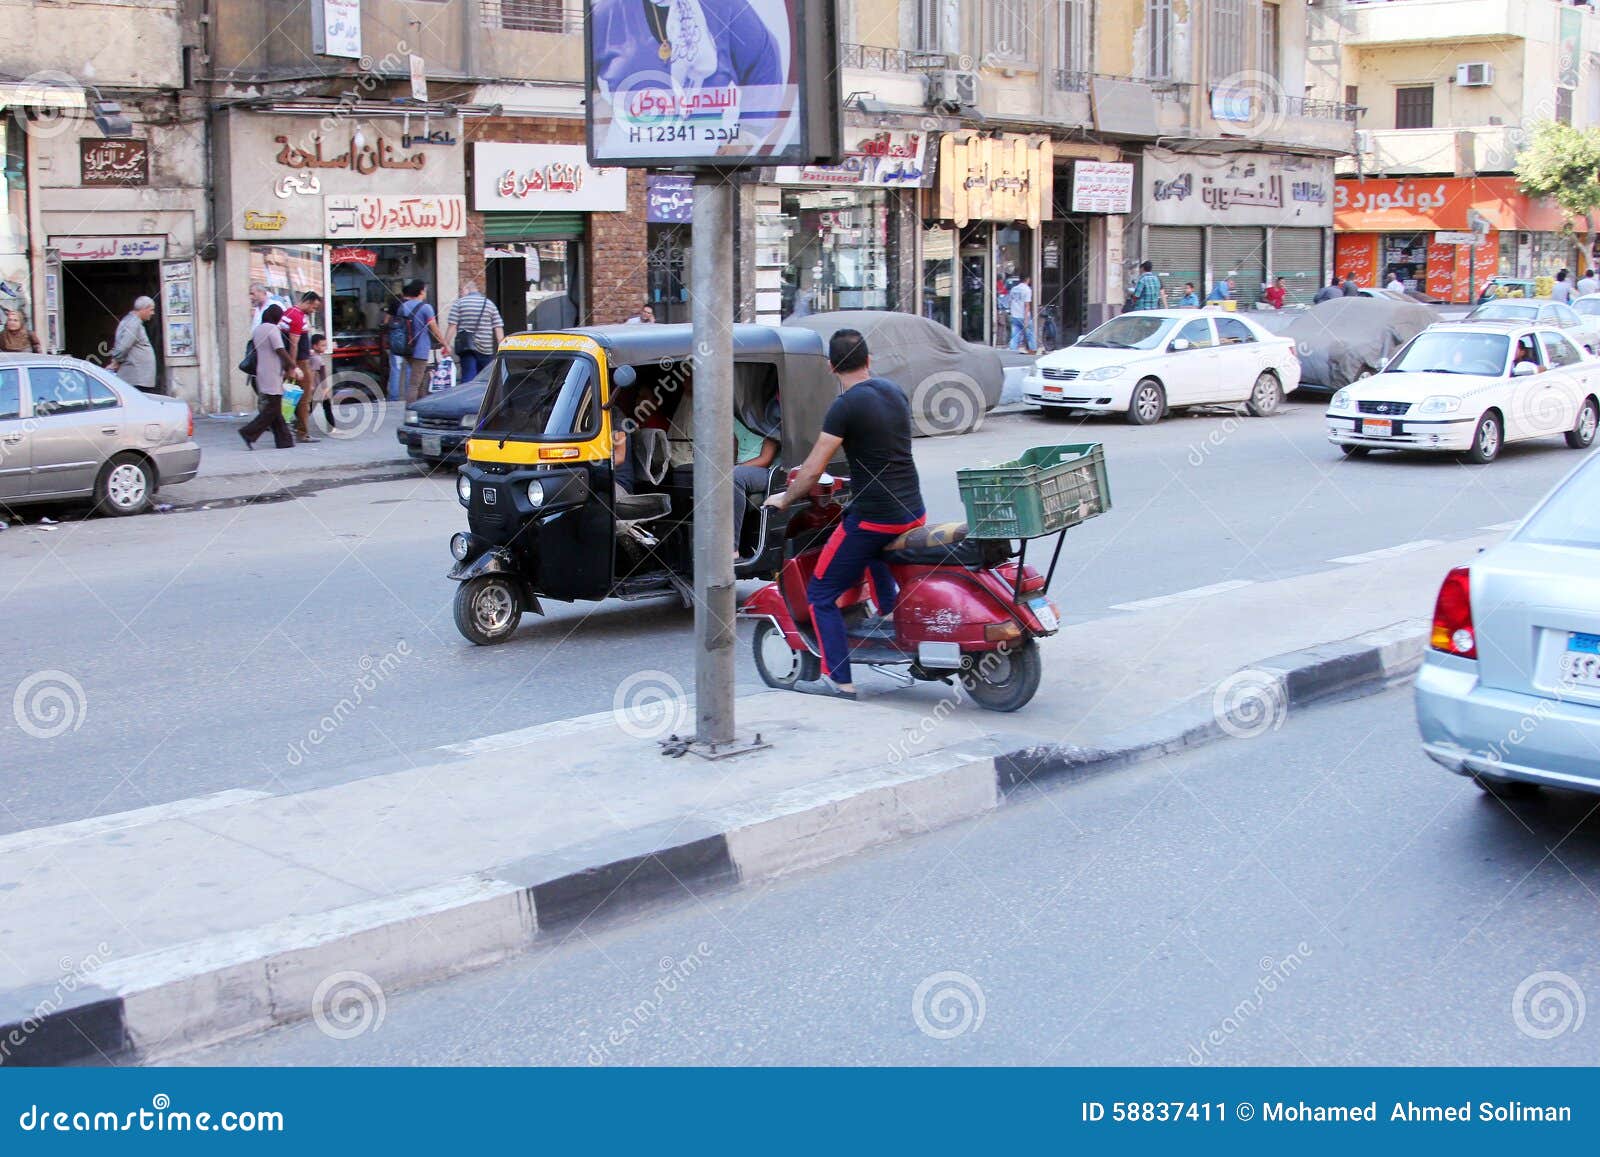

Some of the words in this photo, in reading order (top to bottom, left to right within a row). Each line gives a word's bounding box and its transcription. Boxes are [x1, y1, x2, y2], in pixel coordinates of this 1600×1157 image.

[680, 88, 737, 113] البلدي
[629, 127, 641, 143] H
[648, 126, 695, 142] 12341
[704, 123, 740, 144] تردد
[1353, 184, 1447, 213] كونكورد
